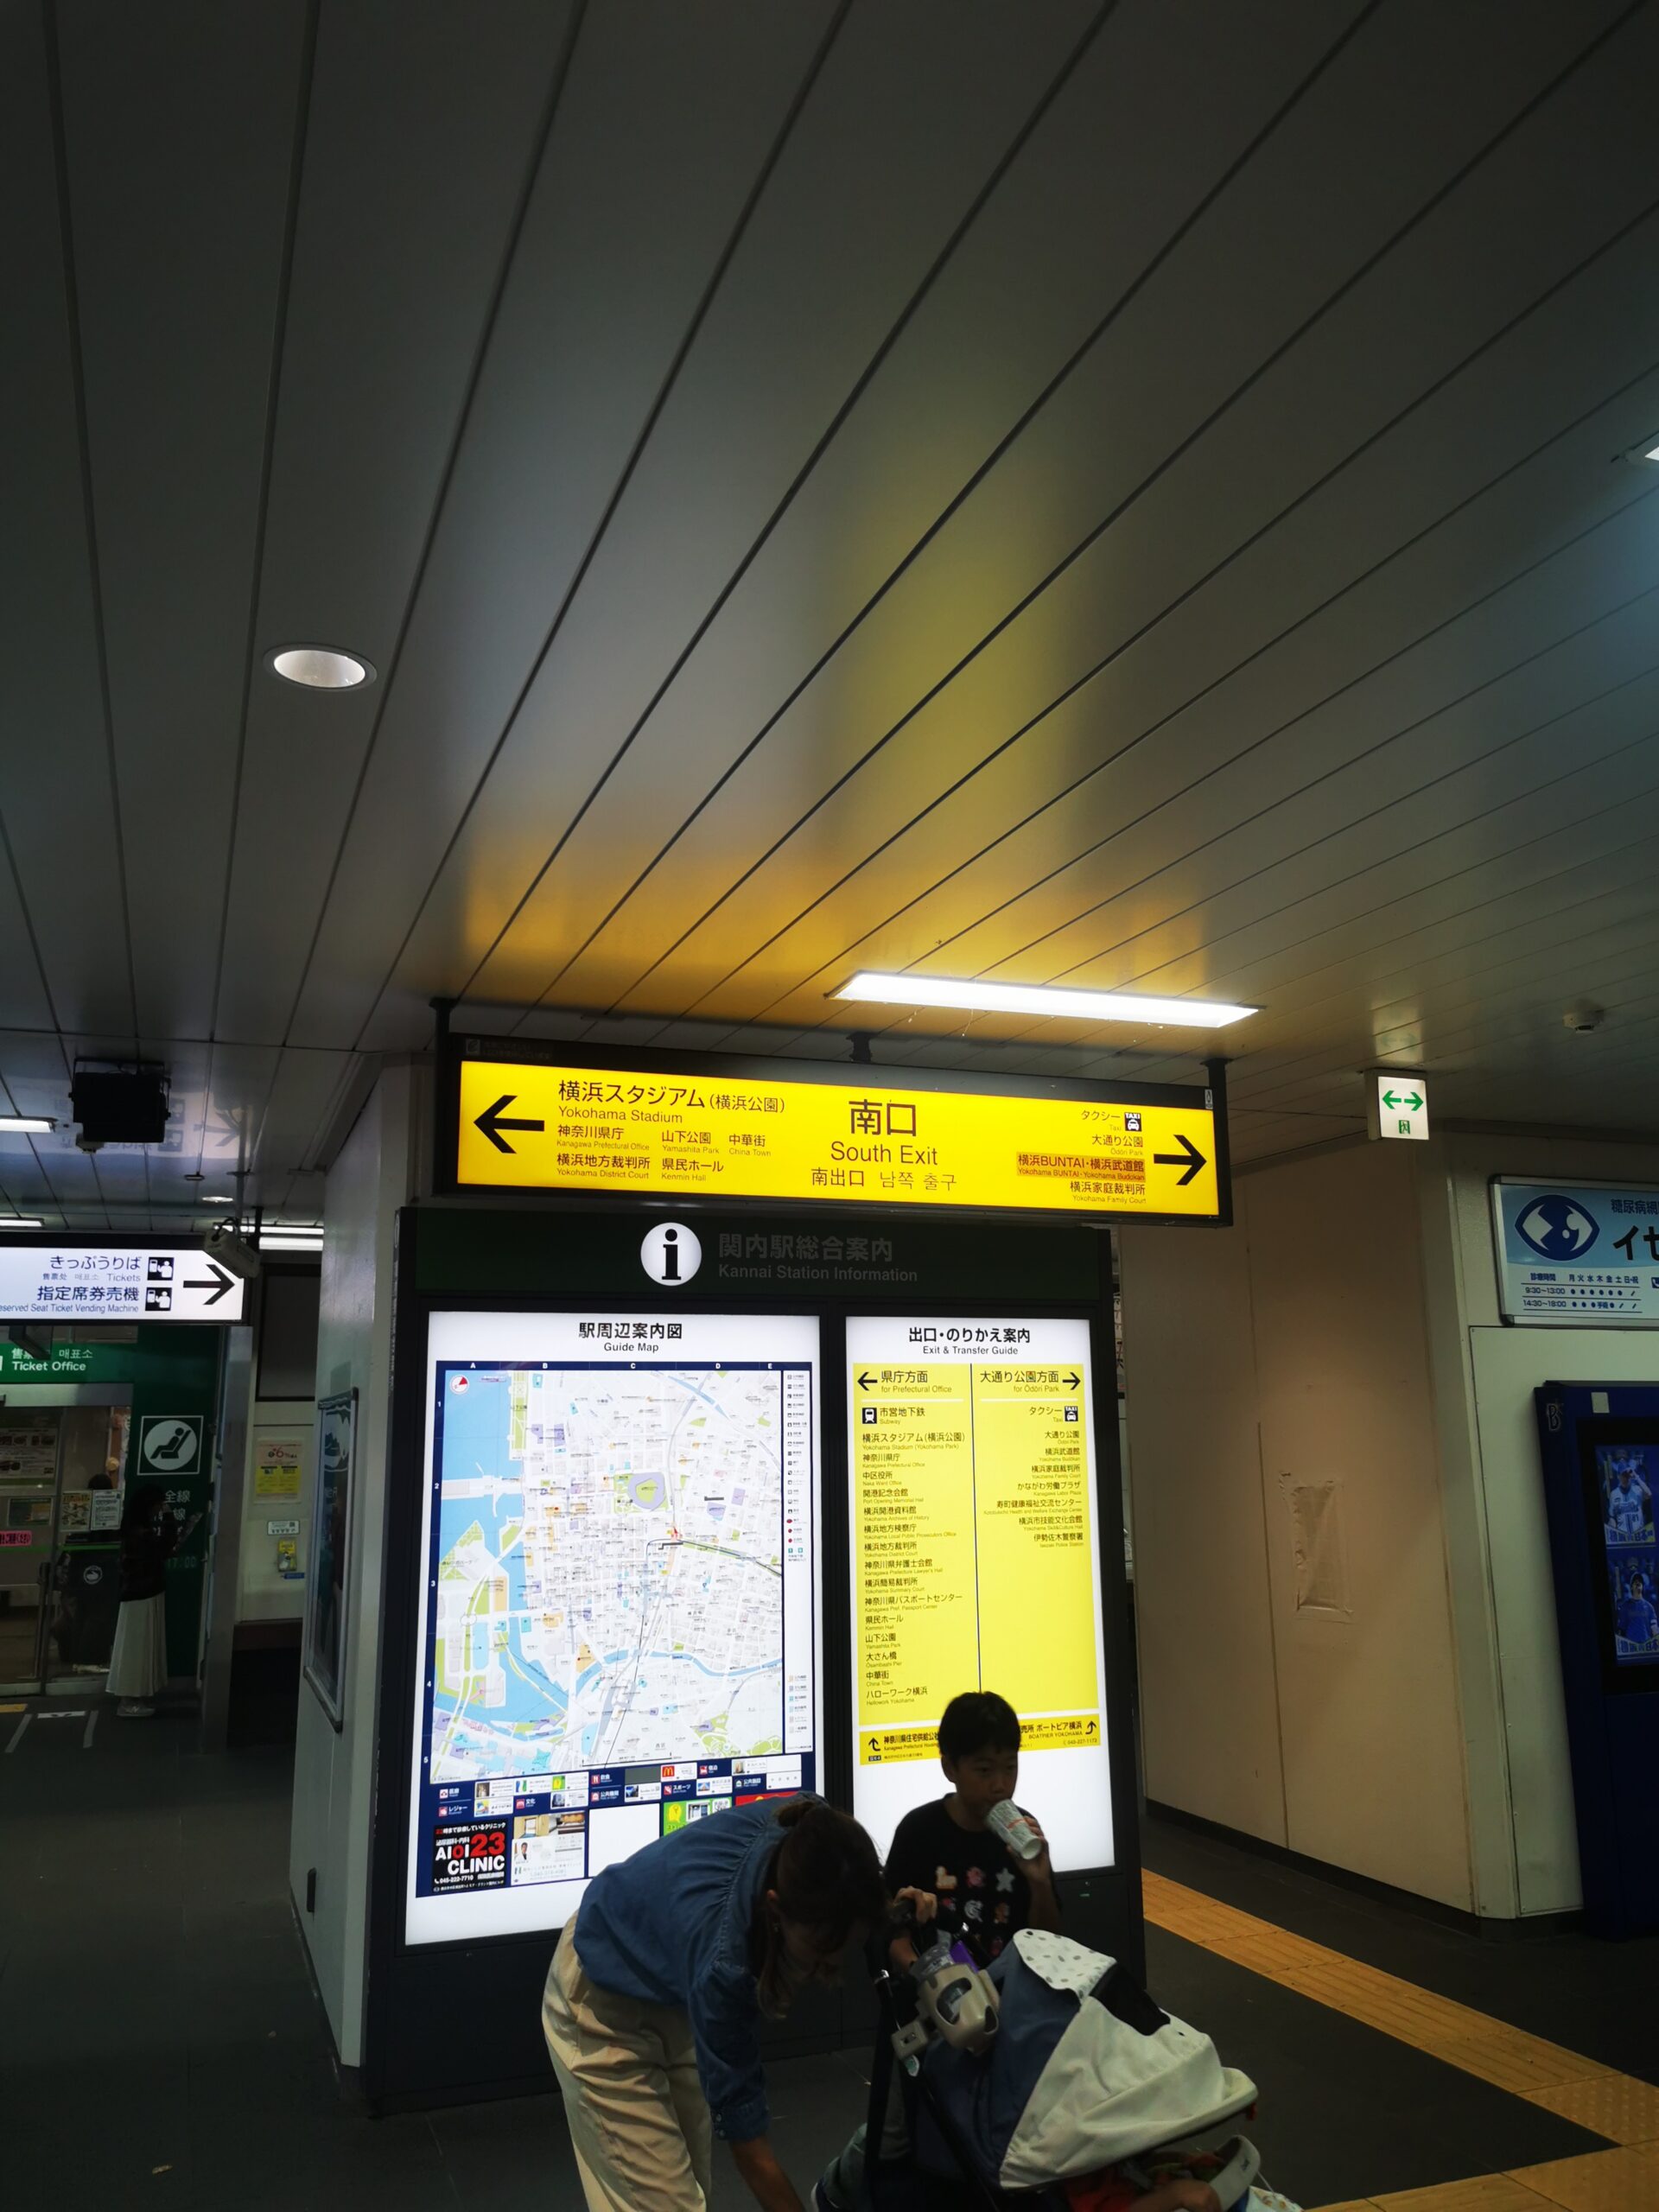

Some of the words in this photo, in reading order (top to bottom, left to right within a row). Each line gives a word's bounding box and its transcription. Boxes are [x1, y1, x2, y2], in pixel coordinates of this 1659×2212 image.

[558, 1106, 626, 1121] Yokohama
[631, 1109, 683, 1123] Stadium
[848, 1098, 917, 1137] 南口
[1081, 1109, 1121, 1122] タクシー
[557, 1124, 624, 1141] 神奈川県庁
[662, 1129, 711, 1145] 山下公園
[728, 1134, 766, 1147] 中華街
[1092, 1135, 1143, 1147] 大通り公園
[556, 1141, 592, 1150] Kanagawa
[594, 1141, 629, 1150] Prefectural
[662, 1145, 701, 1154] Yamashita
[830, 1141, 893, 1164] South
[900, 1145, 938, 1166] Exit
[556, 1154, 650, 1170] 横浜地方裁判所
[662, 1158, 724, 1173] 県民ホール
[556, 1168, 597, 1177] Yokohama
[599, 1170, 626, 1179] District
[661, 1173, 690, 1181] Kenmin
[691, 1173, 706, 1182] Hall
[811, 1167, 865, 1187] 南出口
[1018, 1168, 1052, 1177] Yokohama
[880, 1171, 914, 1190] 남쪽
[924, 1173, 957, 1191] 출구
[1070, 1181, 1146, 1196] 横浜家庭裁判所
[718, 1234, 893, 1262] 関内駅総合案内
[50, 1255, 141, 1270] きっぷうりば
[107, 1273, 141, 1281] Tickets
[719, 1264, 772, 1279] Kannai
[777, 1266, 830, 1280] Station
[834, 1267, 918, 1282] Information
[37, 1286, 139, 1301] 指定席券売機
[50, 1304, 73, 1313] Ticket
[75, 1304, 105, 1314] Vending
[108, 1304, 138, 1313] Machine
[579, 1322, 683, 1340] 駅周辺案内図
[909, 1327, 1031, 1344] 出口・のりかえ案内
[59, 1349, 92, 1359] 매표소
[603, 1342, 635, 1352] Guide
[638, 1343, 659, 1354] Map
[952, 1346, 989, 1355] Transfer
[992, 1346, 1018, 1355] Guide
[12, 1361, 48, 1370] Ticket
[52, 1361, 86, 1370] Office
[881, 1370, 928, 1384] 県庁方面
[980, 1370, 1059, 1384] 大通り公園方面
[880, 1408, 925, 1417] 市営地下鉄
[1029, 1407, 1062, 1415] タクシー
[862, 1453, 900, 1462] 神奈川県庁
[862, 1471, 893, 1480] 中区役所
[865, 1615, 904, 1624] 県民ホール
[865, 1633, 896, 1643] 山下公園
[470, 1831, 505, 1858] 23
[447, 1855, 505, 1875] CLINIC
